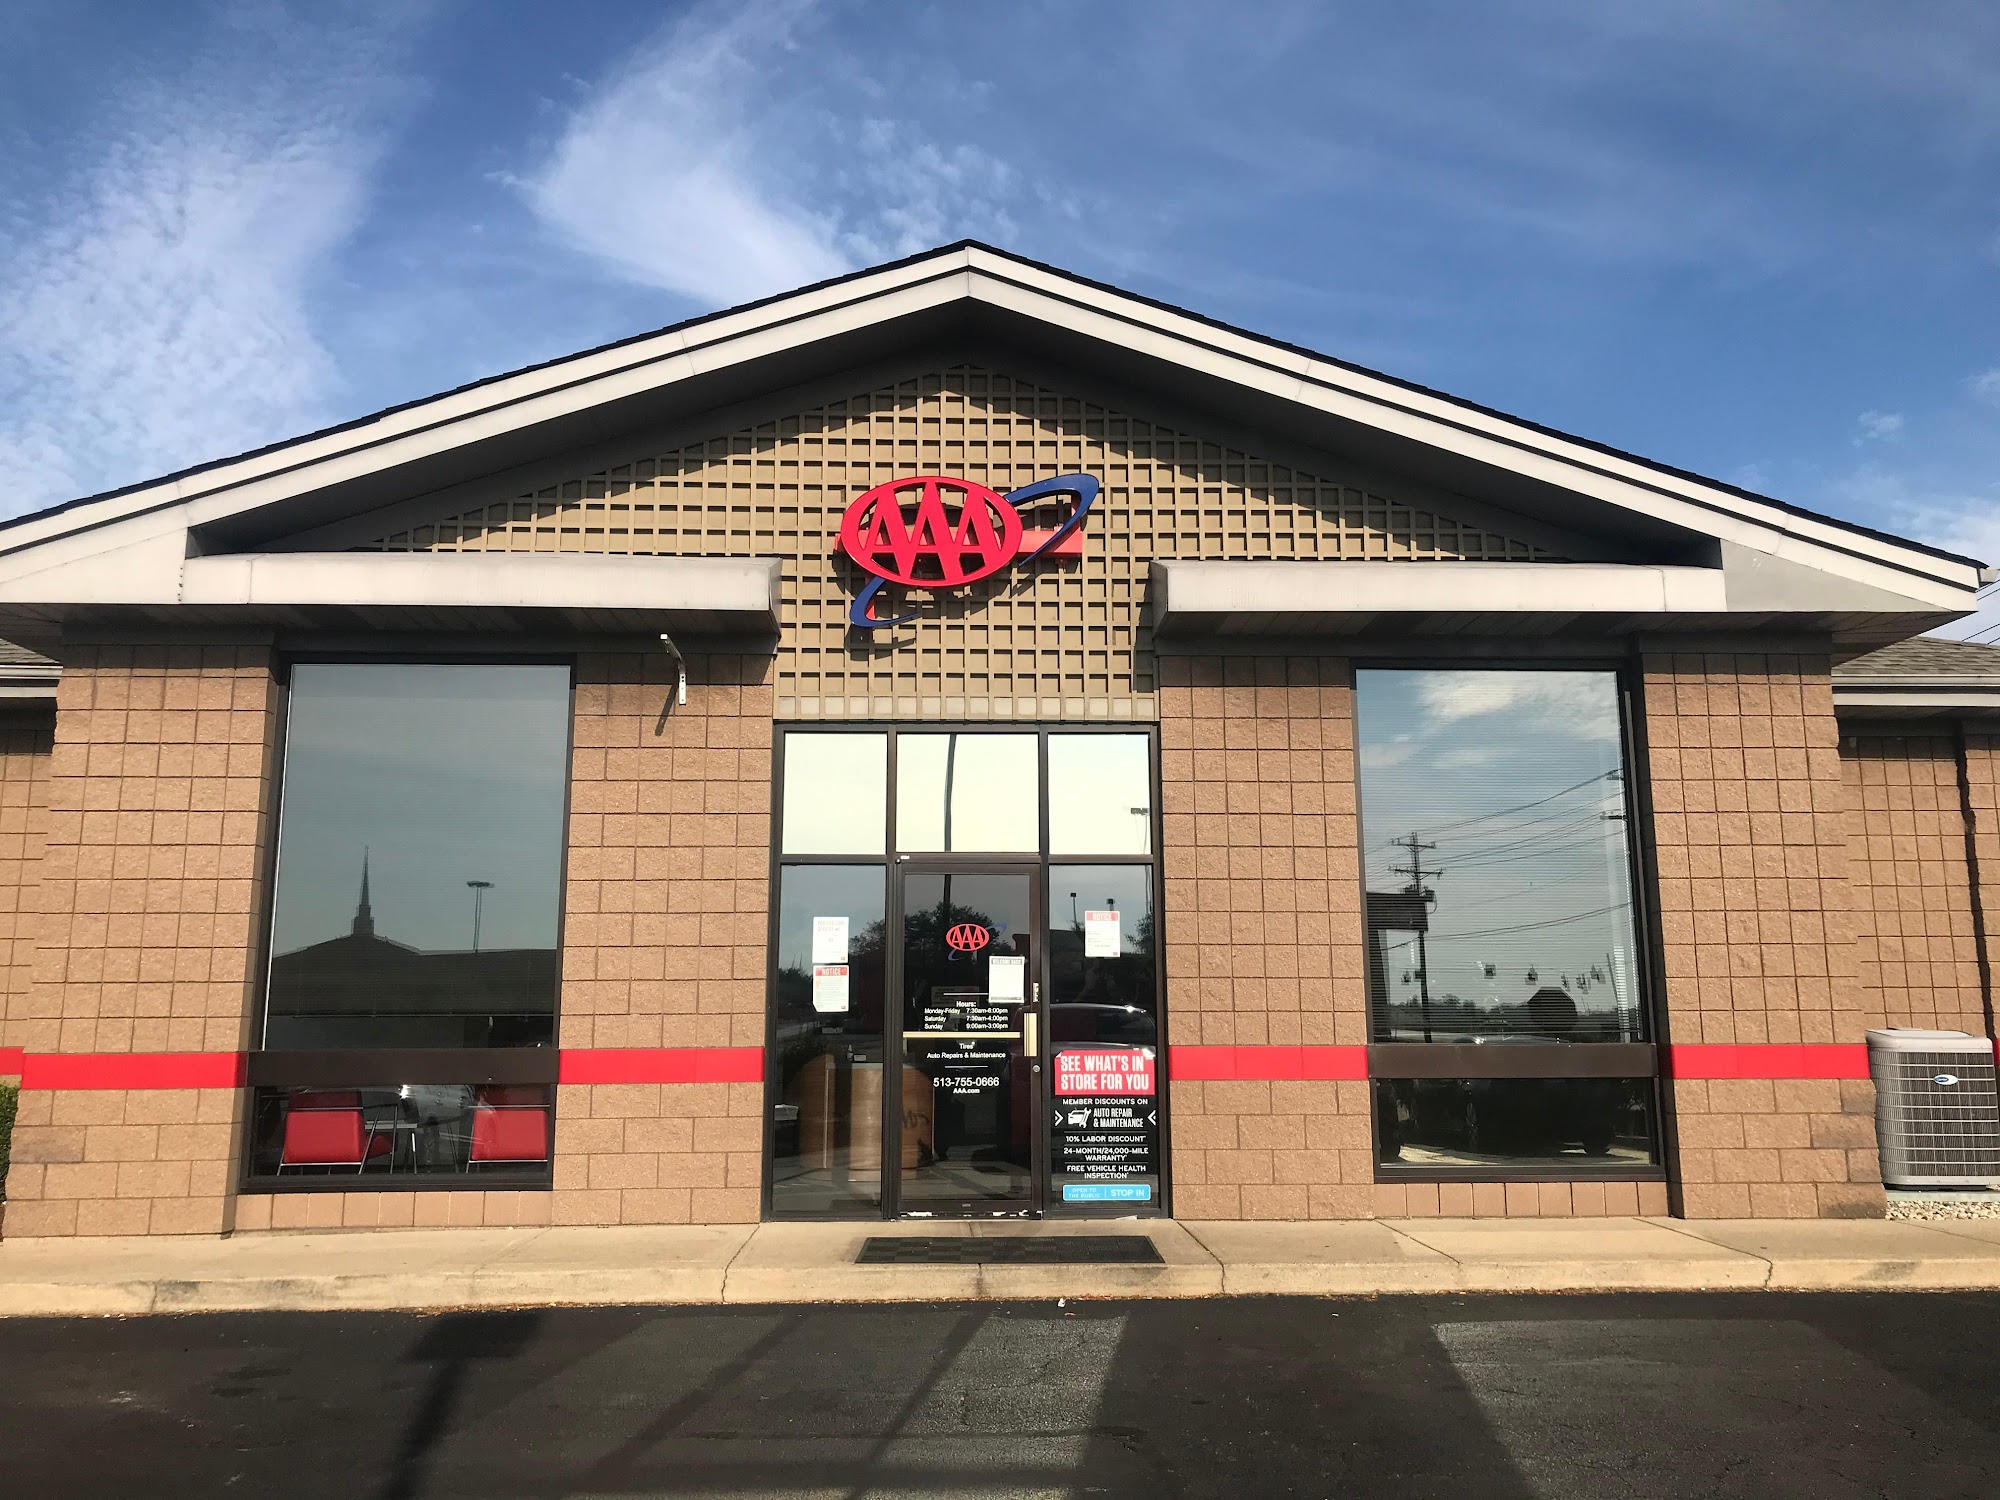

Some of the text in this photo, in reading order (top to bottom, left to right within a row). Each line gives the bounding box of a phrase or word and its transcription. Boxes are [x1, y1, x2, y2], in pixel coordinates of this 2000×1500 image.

[846, 476, 1016, 586] AAA
[1092, 912, 1113, 921] NOTICE
[946, 924, 989, 951] AAA
[821, 967, 842, 976] NOTICE
[924, 1007, 961, 1015] Monday-Friday
[924, 1015, 947, 1023] Saturday
[924, 1023, 944, 1031] Sunday
[941, 1052, 963, 1060] Repairs
[969, 1051, 1006, 1059] Maintenance
[1060, 1055, 1144, 1072] SEE WHAT'S IN
[933, 1076, 1000, 1087] 513-755-0666
[1060, 1073, 1149, 1091] STORE FOR YOU
[1093, 1107, 1133, 1118] AUTO REPAIR
[1093, 1118, 1144, 1128] & MAINTENANCE
[1063, 1147, 1149, 1155] 24-MONTH/24,000-MILE
[1110, 1189, 1145, 1197] STOP IN
